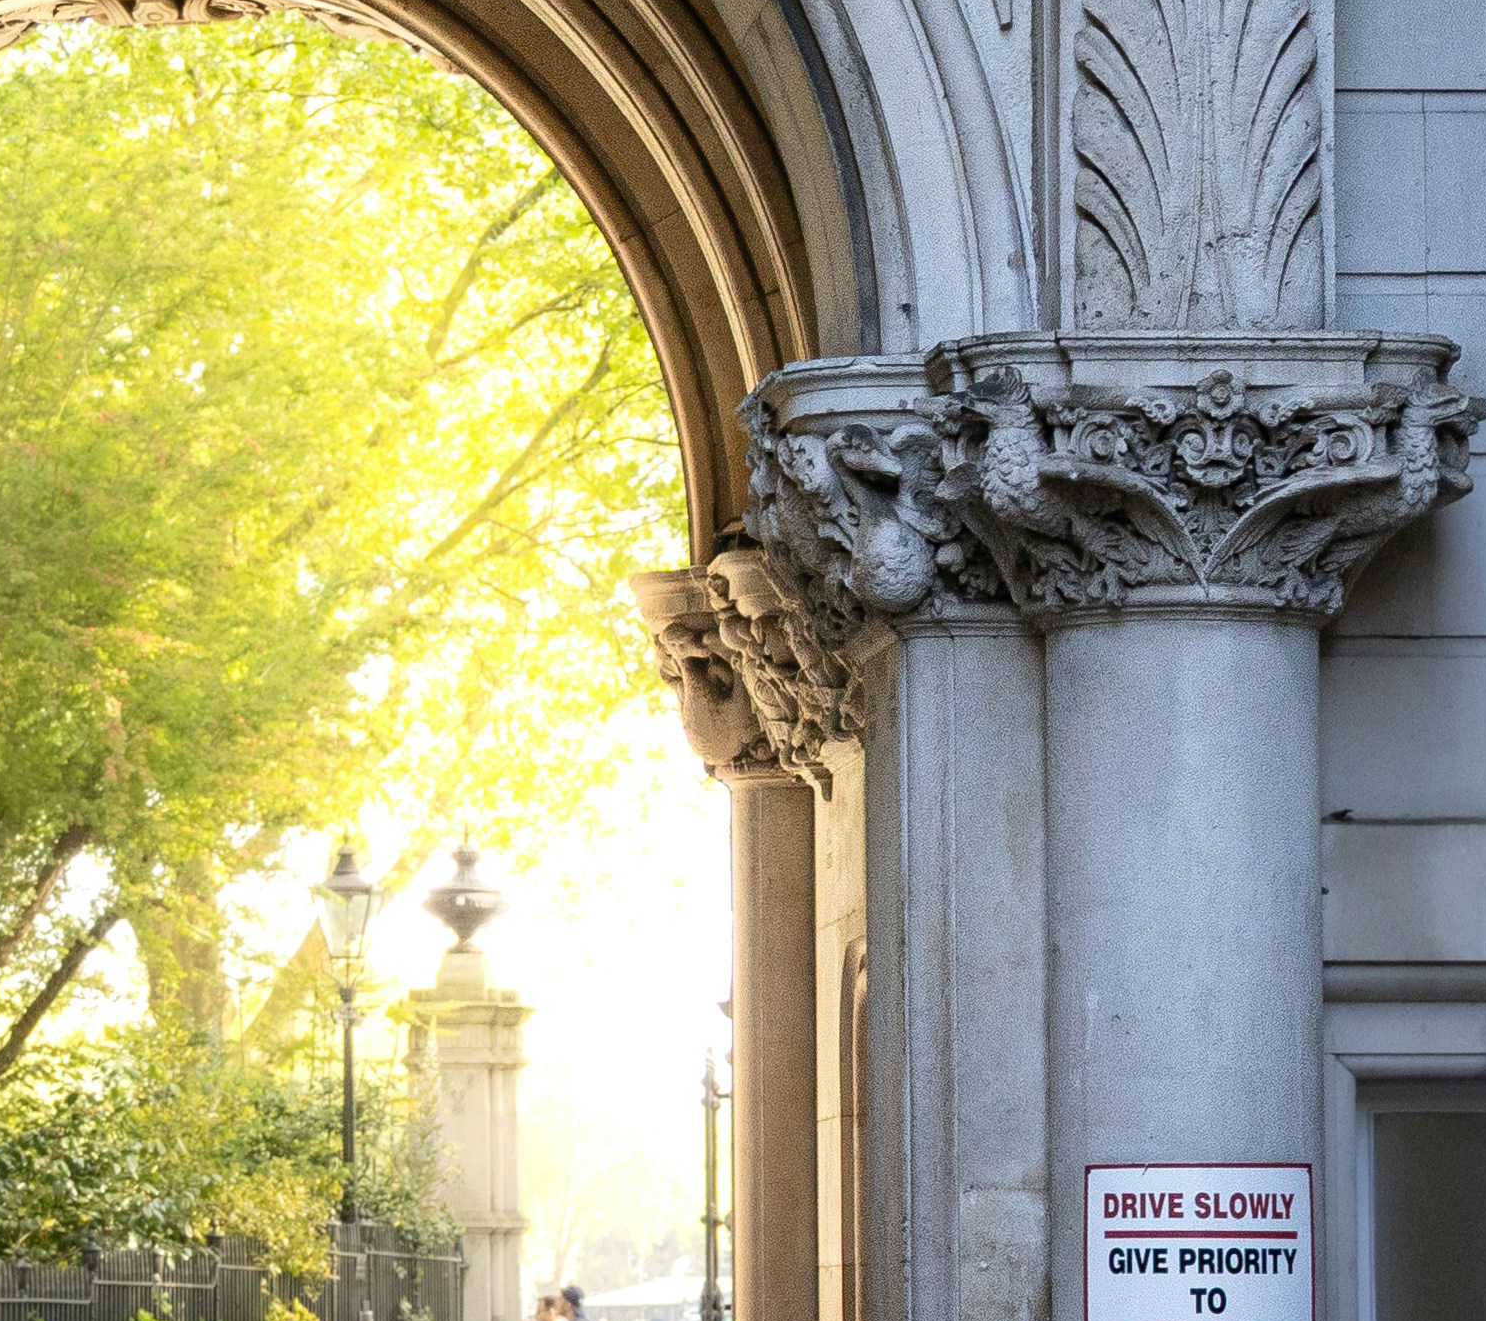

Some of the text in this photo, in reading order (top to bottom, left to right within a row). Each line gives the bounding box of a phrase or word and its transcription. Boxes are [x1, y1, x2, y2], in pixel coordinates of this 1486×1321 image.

[1103, 1192, 1295, 1220] DRIVE SLOWLY
[1109, 1247, 1298, 1275] GIVE PRIORITY
[1190, 1287, 1227, 1314] TO
